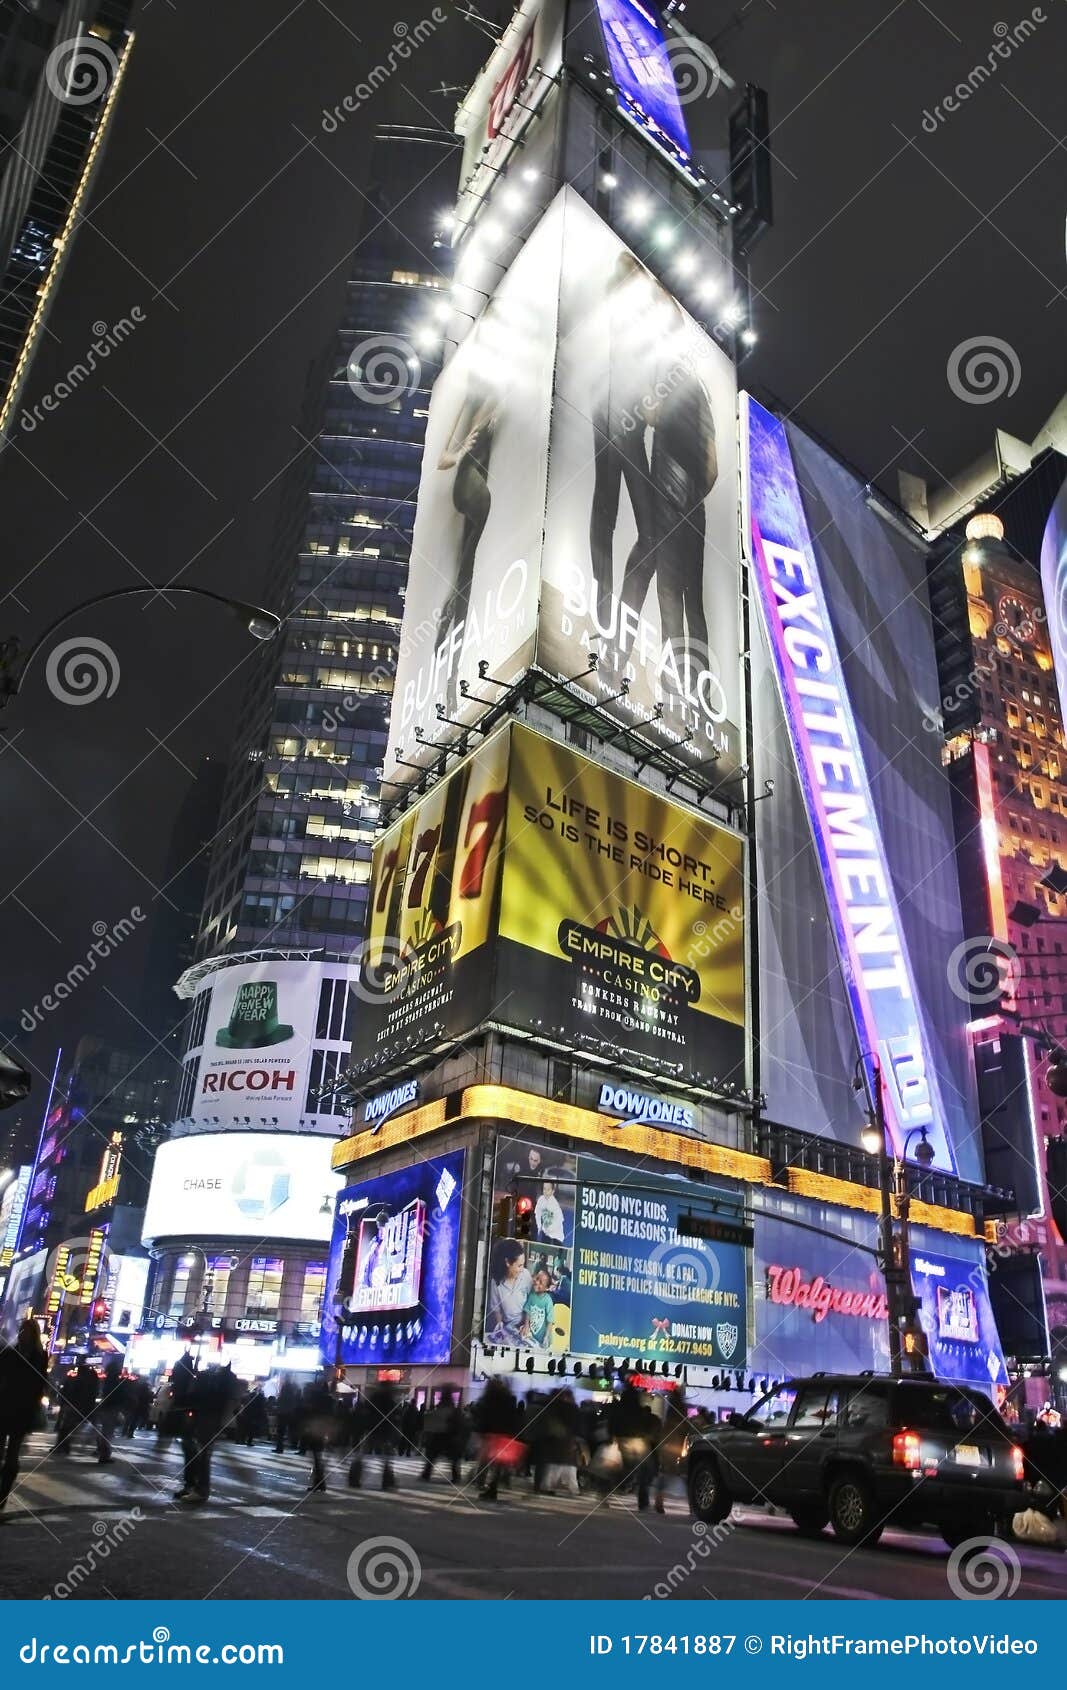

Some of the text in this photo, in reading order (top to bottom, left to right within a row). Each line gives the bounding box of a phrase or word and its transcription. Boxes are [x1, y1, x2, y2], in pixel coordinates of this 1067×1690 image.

[400, 558, 528, 732] BUFFALO
[560, 562, 728, 723] BUFFALO
[561, 614, 636, 683] DAVID
[654, 683, 730, 753] BITTON
[761, 538, 911, 999] EXCITEMENT
[546, 786, 715, 885] LIFE IS SHORT.
[524, 805, 731, 914] SO IS THE RIDE HERE.
[384, 936, 457, 993] EMPIRE CITY
[567, 929, 645, 975] EMPIRE
[241, 985, 274, 1000] HAPPY
[400, 970, 433, 1000] CASINO
[603, 970, 660, 1002] CASINO
[239, 1008, 267, 1021] YEAR
[572, 997, 687, 1045] TRAIN FROM GRAND CENTRAL
[582, 982, 679, 1026] YONKERS RACEWAY
[202, 1070, 296, 1094] RICOH
[184, 1178, 223, 1190] CHASE
[582, 1187, 669, 1223] 50,000 NYC KIDS.
[580, 1210, 619, 1235] 50,000
[621, 1218, 667, 1245] REASONS
[668, 1227, 681, 1246] TO
[580, 1248, 599, 1266] THIS
[600, 1251, 632, 1272] HOLIDAY
[666, 1263, 676, 1280] BE
[676, 1265, 682, 1281] A
[578, 1269, 740, 1308] GIVE TO THE POLICE ATHLETIC LEAGUE OF NYC.
[768, 1264, 889, 1323] Walgreens
[234, 1319, 280, 1332] CHASE
[672, 1322, 713, 1341] DONATE NOW
[598, 1331, 647, 1352] palnyc.org
[647, 1338, 657, 1351] or
[659, 1339, 713, 1358] 212.477.9450
